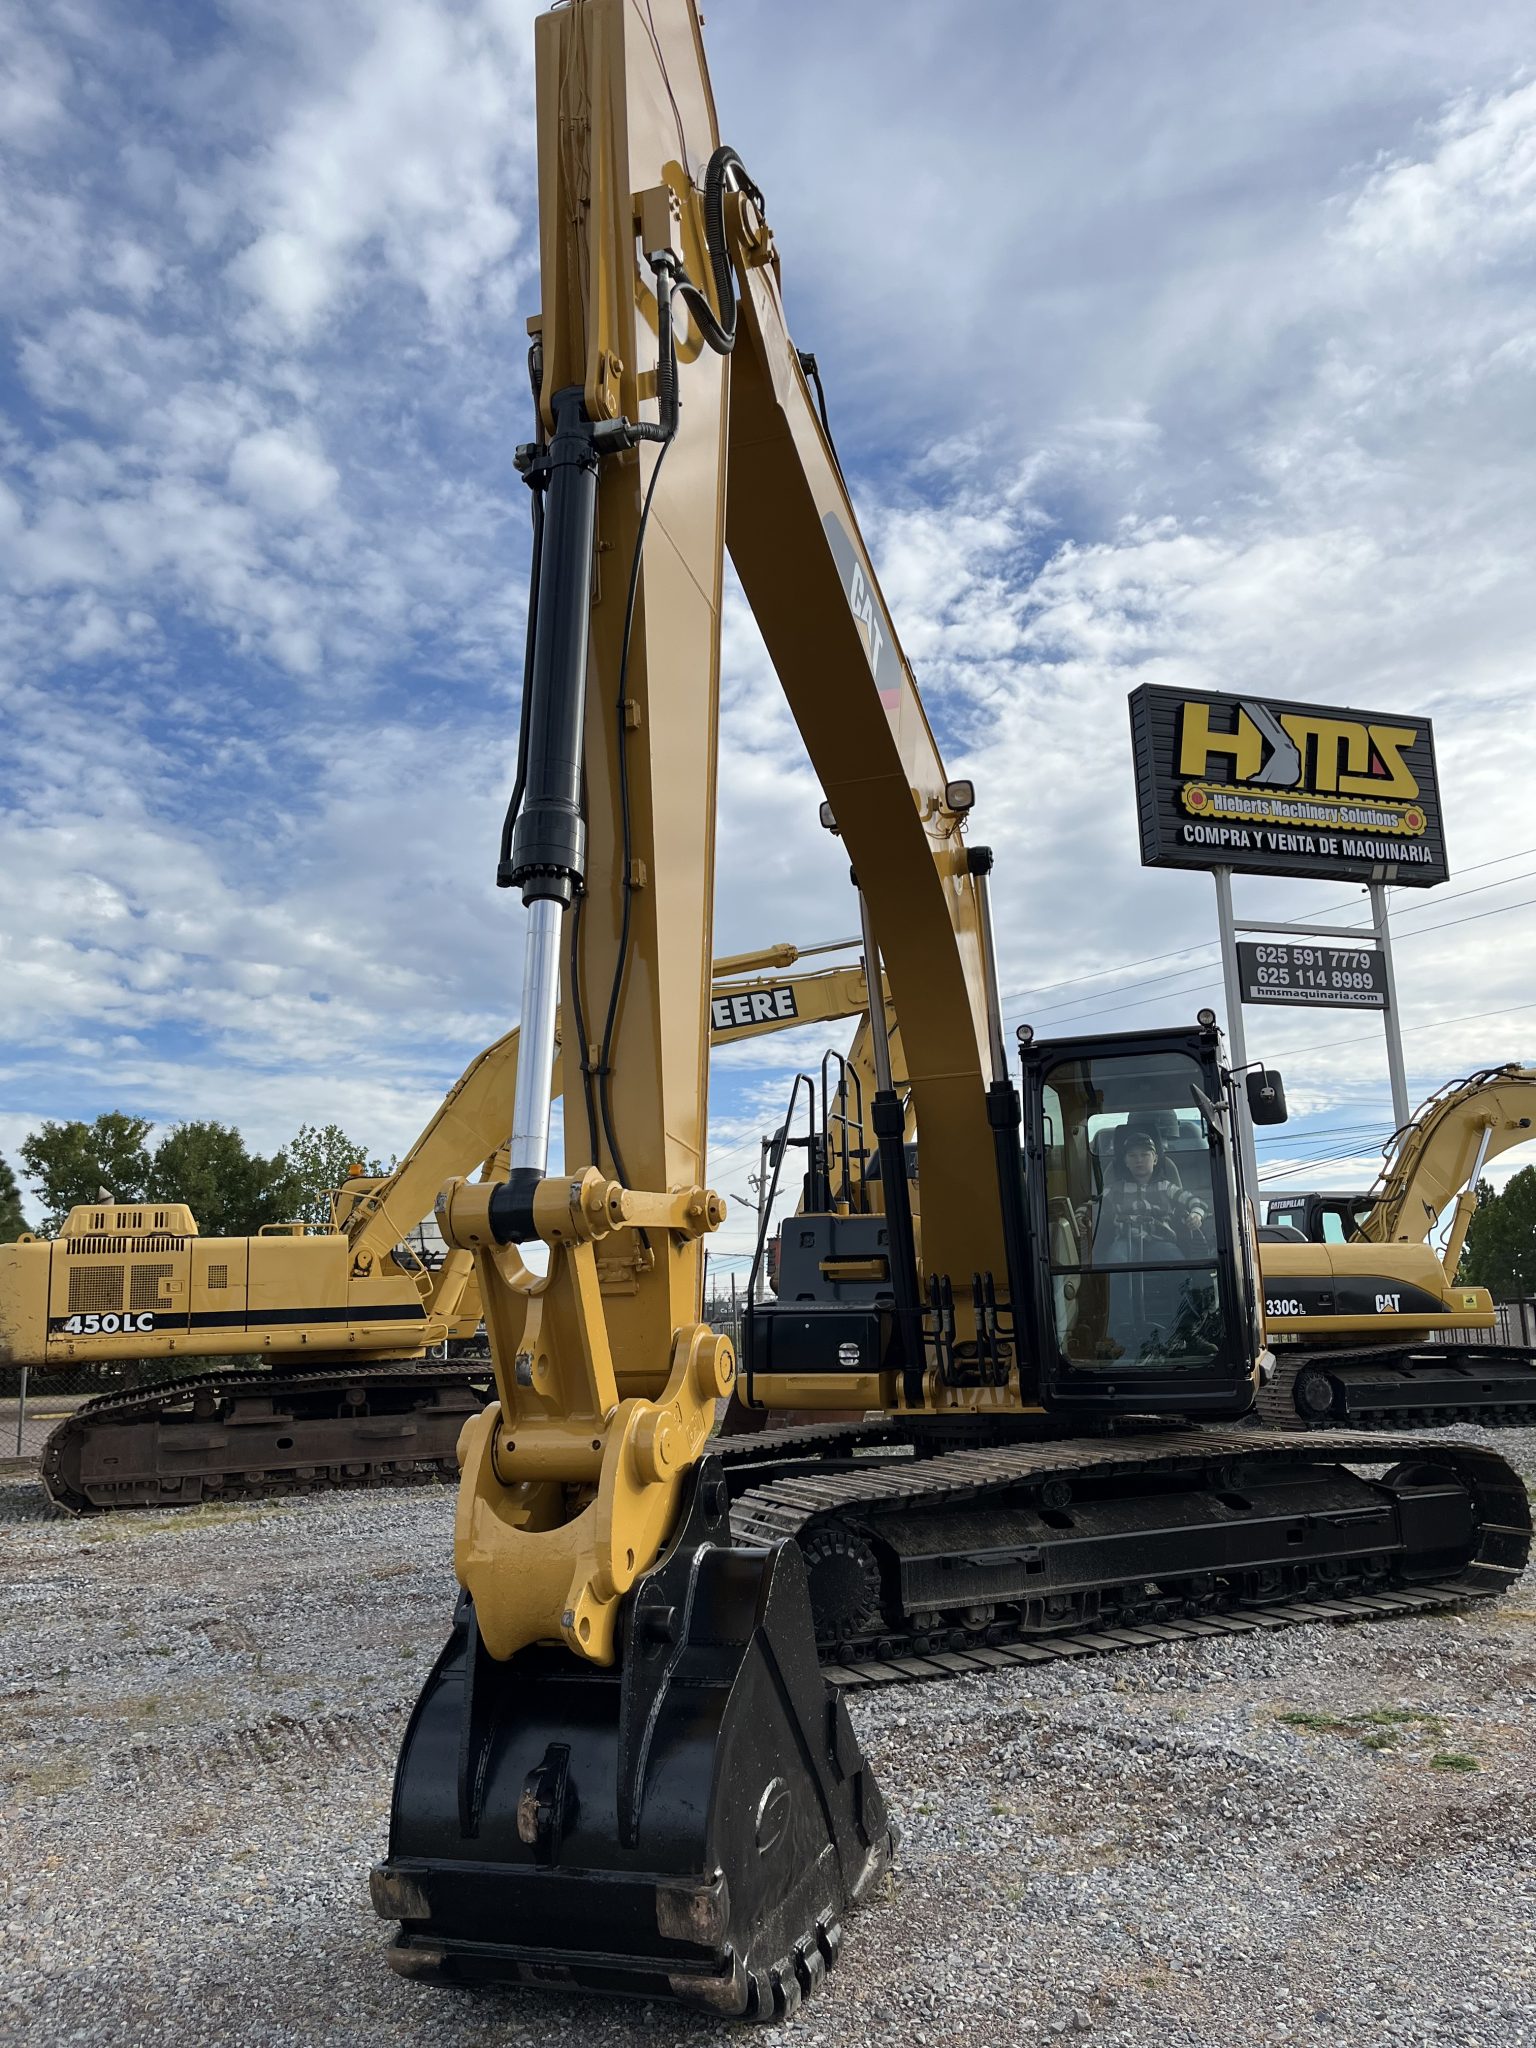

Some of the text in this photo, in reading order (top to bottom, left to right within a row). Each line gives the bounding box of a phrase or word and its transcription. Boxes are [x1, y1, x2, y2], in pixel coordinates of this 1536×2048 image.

[850, 561, 884, 678] CAT
[1179, 701, 1420, 799] HMS
[1213, 794, 1399, 827] Hieberts Machinery Solutions
[1183, 824, 1433, 863] COMPRA Y VENTA DE MAQUINARIA
[1255, 946, 1371, 969] 625 591 7779
[1257, 966, 1374, 989] 625 114 8989
[712, 988, 795, 1028] EERE
[1257, 987, 1378, 1001] hmsmaquinaria.com
[1270, 1198, 1306, 1210] CATERPILLAR
[1375, 1294, 1401, 1313] CAT
